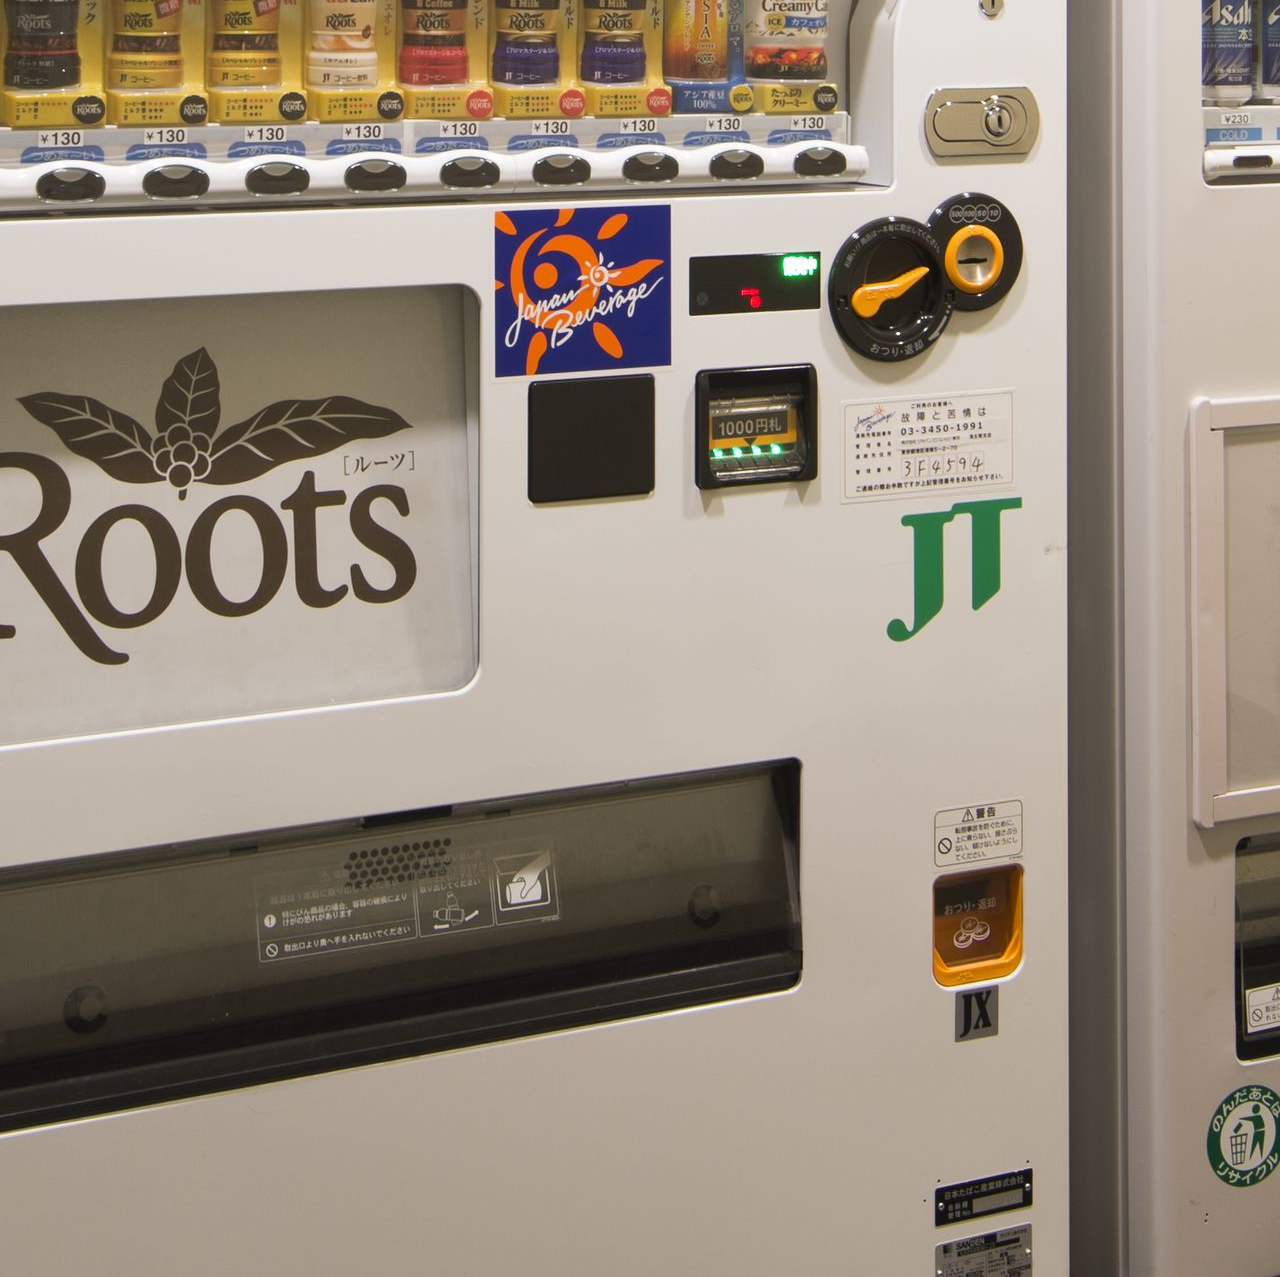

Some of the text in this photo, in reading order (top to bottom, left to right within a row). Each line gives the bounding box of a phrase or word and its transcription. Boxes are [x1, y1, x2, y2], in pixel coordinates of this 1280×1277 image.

[692, 99, 718, 110] 100%
[504, 277, 665, 348] Japan Beverage
[718, 417, 783, 437] 1000円札
[900, 422, 983, 436] 03-3450-1991
[886, 496, 1023, 643] JT
[959, 990, 993, 1039] JX
[1216, 1152, 1279, 1185] リサイクル
